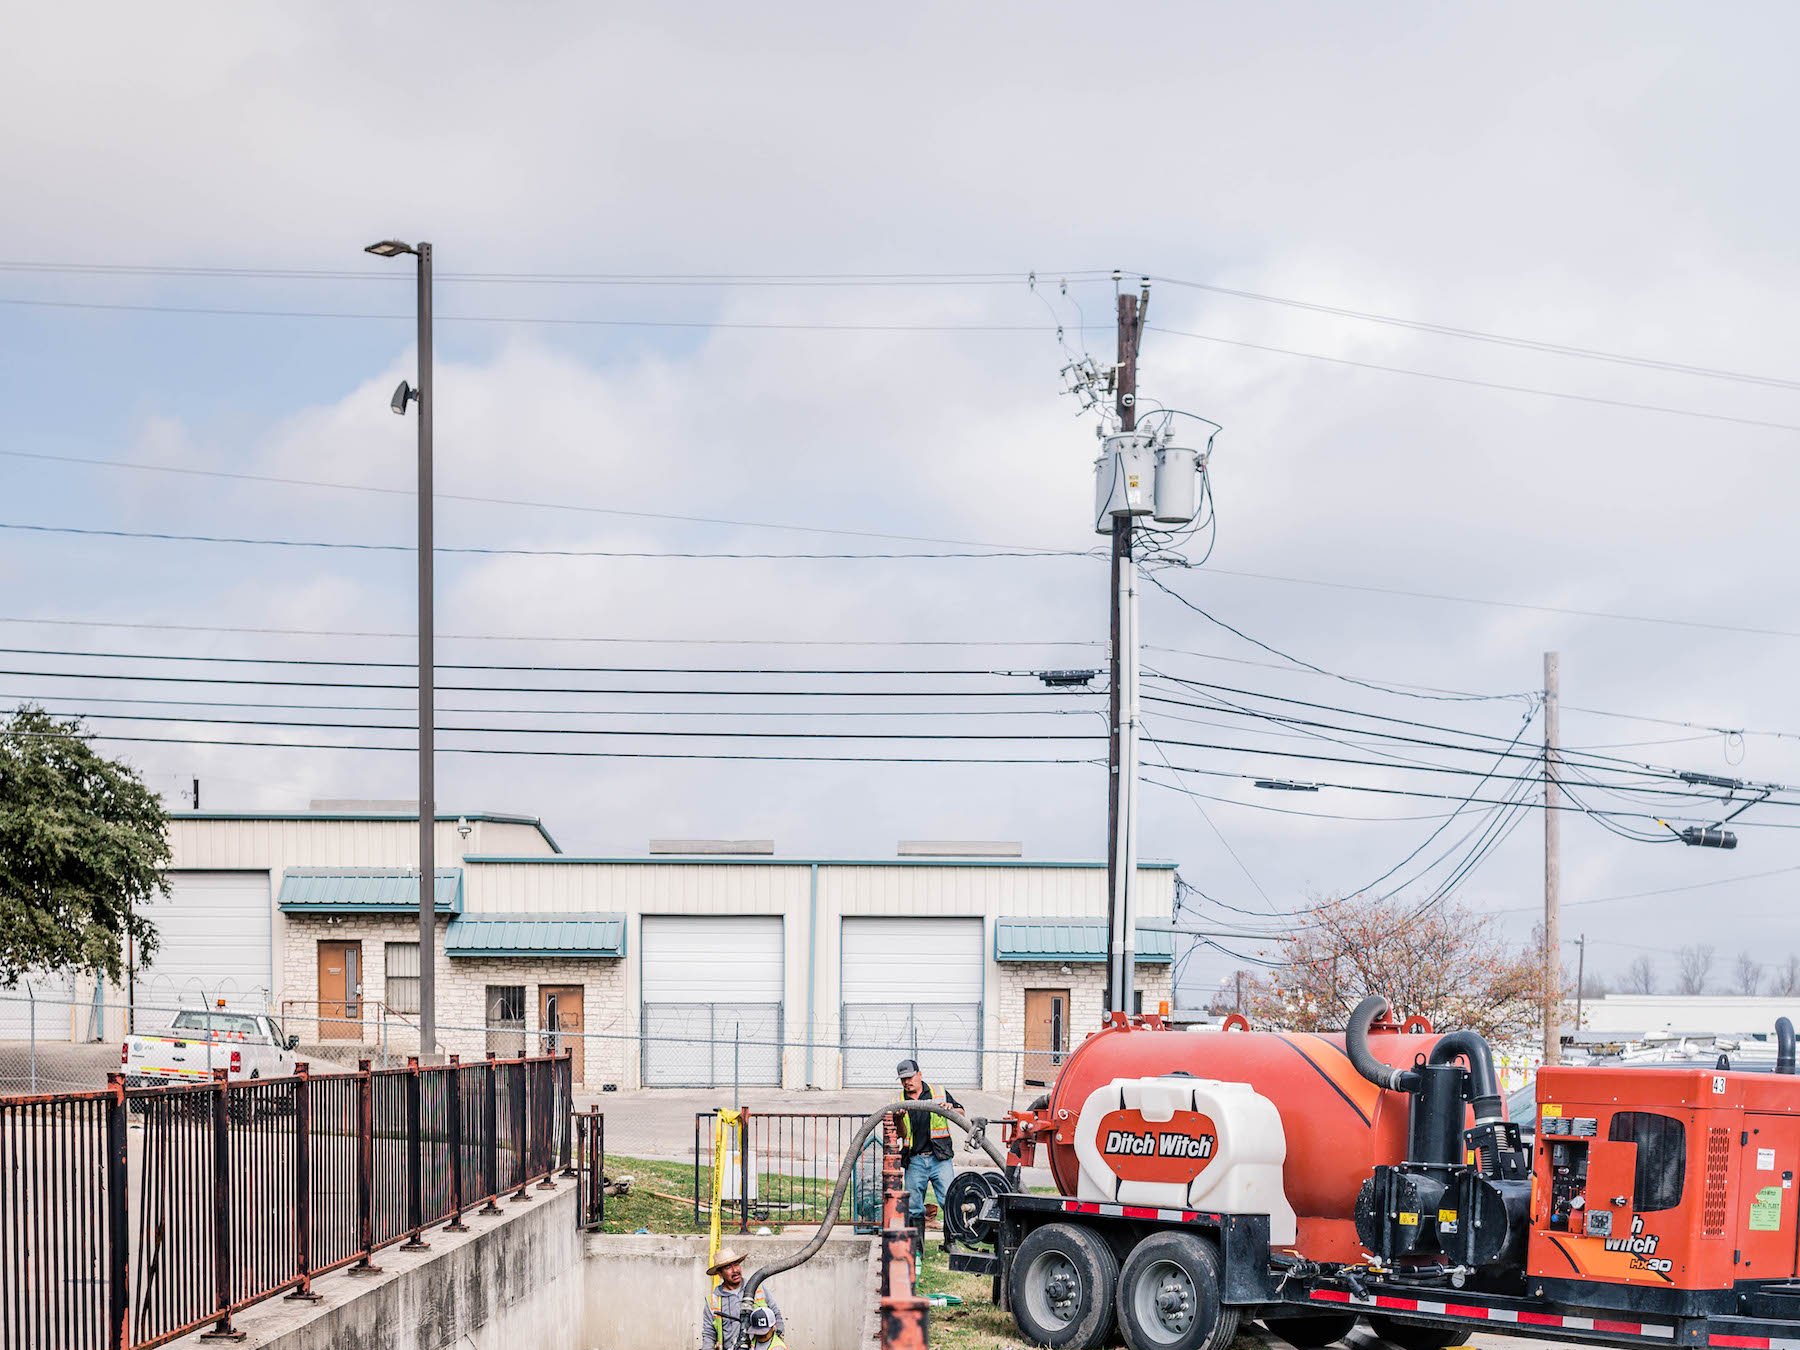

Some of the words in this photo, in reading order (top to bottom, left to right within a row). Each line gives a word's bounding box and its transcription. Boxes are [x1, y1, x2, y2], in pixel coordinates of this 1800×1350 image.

[1714, 1079, 1725, 1092] 43
[1105, 1131, 1156, 1155] Ditch
[1159, 1134, 1211, 1157] Witch
[1630, 1258, 1672, 1272] HX30
